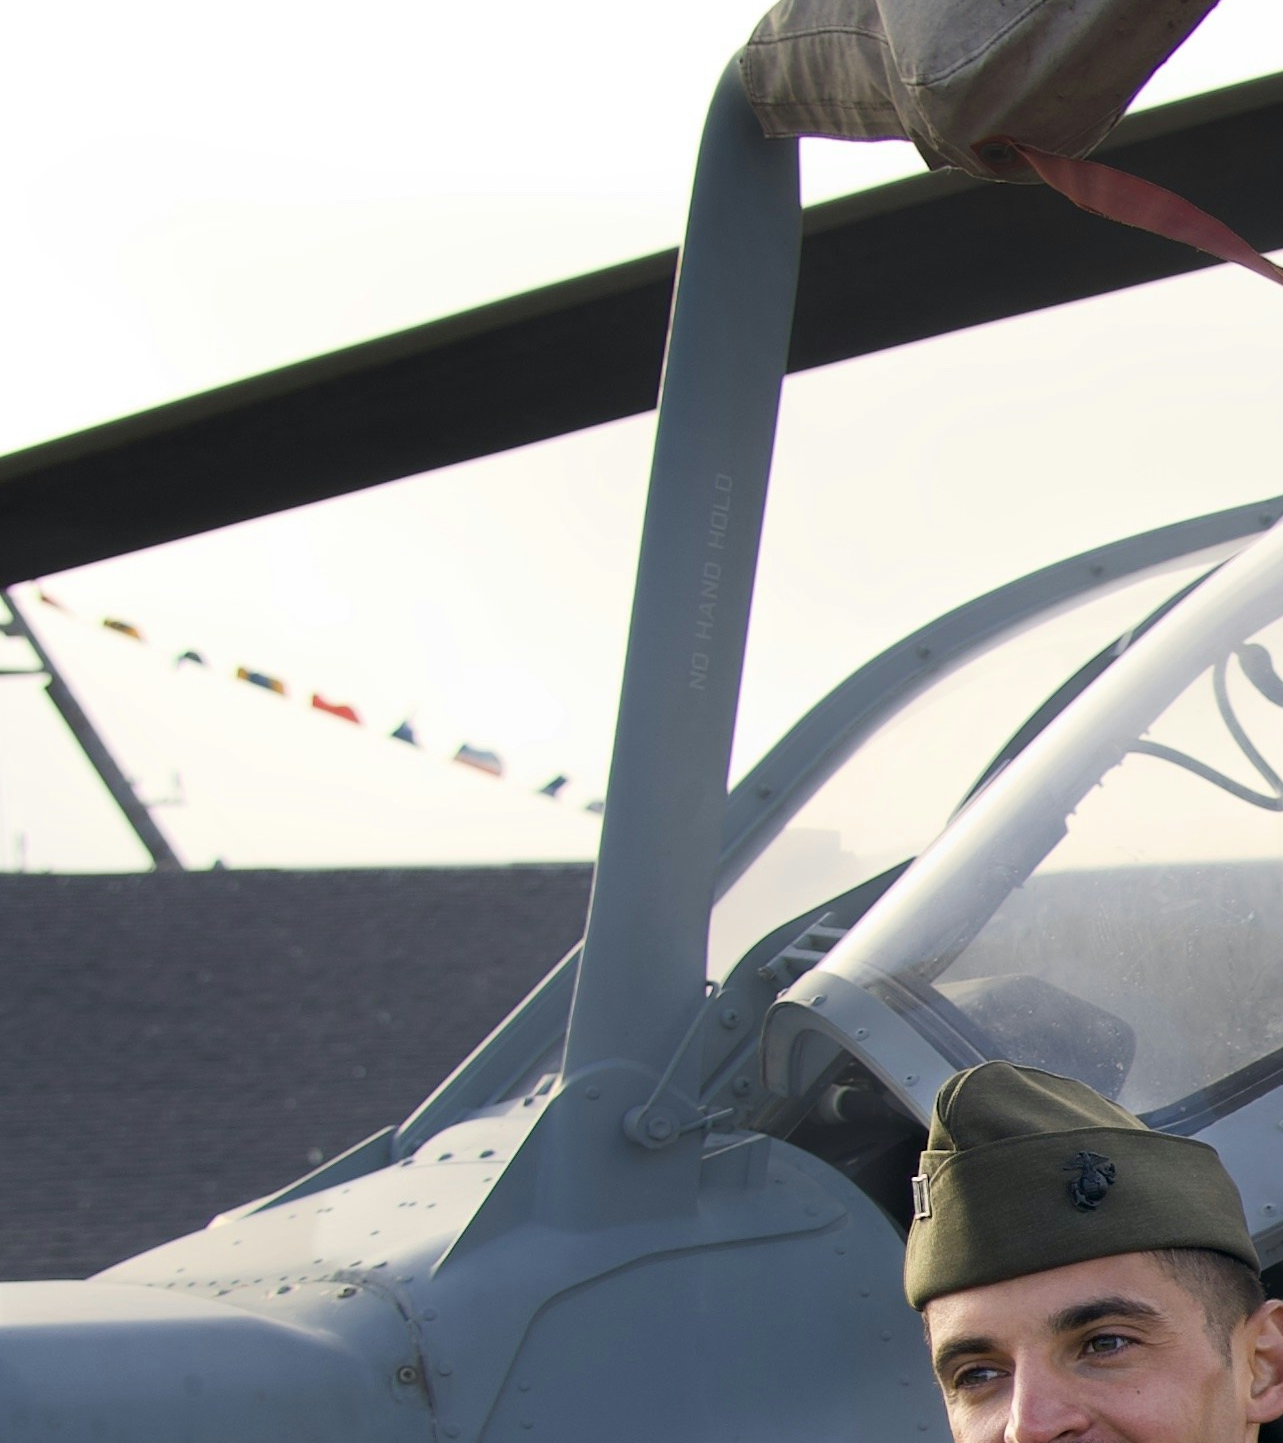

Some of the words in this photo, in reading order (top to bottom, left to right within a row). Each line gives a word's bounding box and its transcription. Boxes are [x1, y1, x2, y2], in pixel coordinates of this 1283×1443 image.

[707, 473, 733, 550] HOLD
[695, 561, 722, 640] HAND
[689, 651, 710, 691] NO
